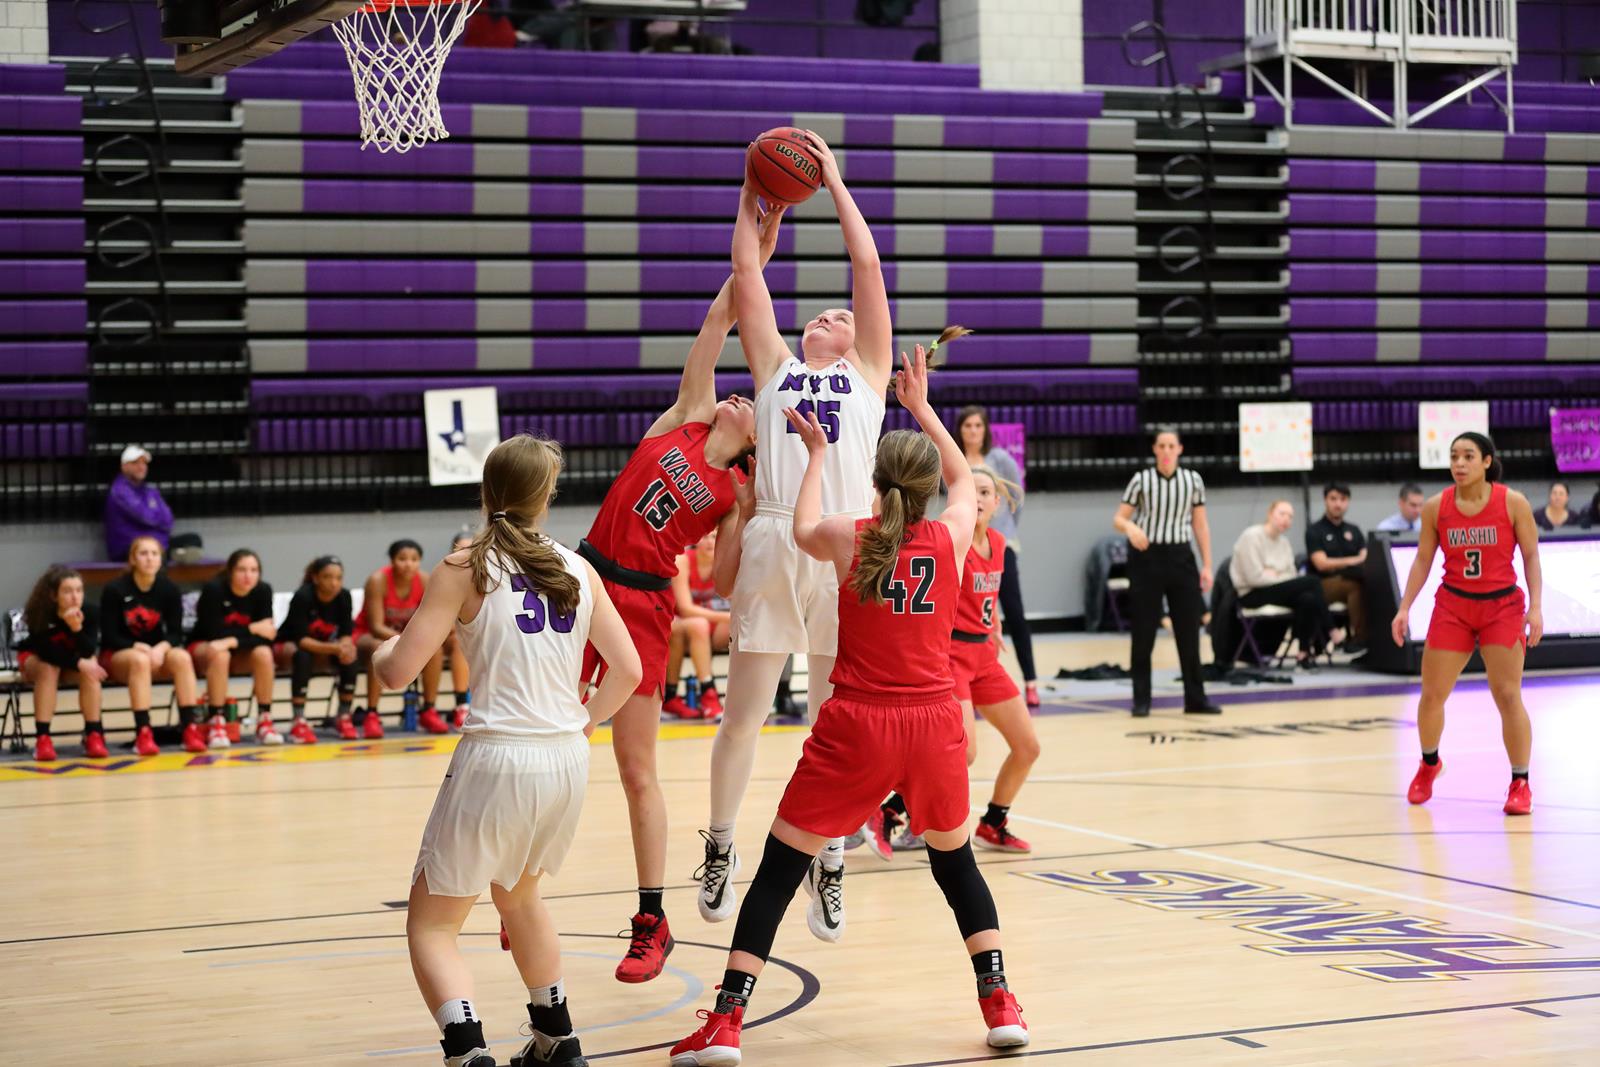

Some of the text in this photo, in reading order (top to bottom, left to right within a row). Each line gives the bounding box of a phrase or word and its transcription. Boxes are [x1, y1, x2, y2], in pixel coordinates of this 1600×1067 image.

[775, 143, 819, 181] Wilson
[778, 372, 852, 395] NYU
[658, 446, 716, 514] WASHU
[632, 477, 680, 531] 15
[1447, 526, 1498, 547] WASHU
[1463, 548, 1482, 579] 3
[880, 556, 936, 614] 42
[980, 596, 994, 629] 5
[1007, 869, 1600, 983] HAWKS
